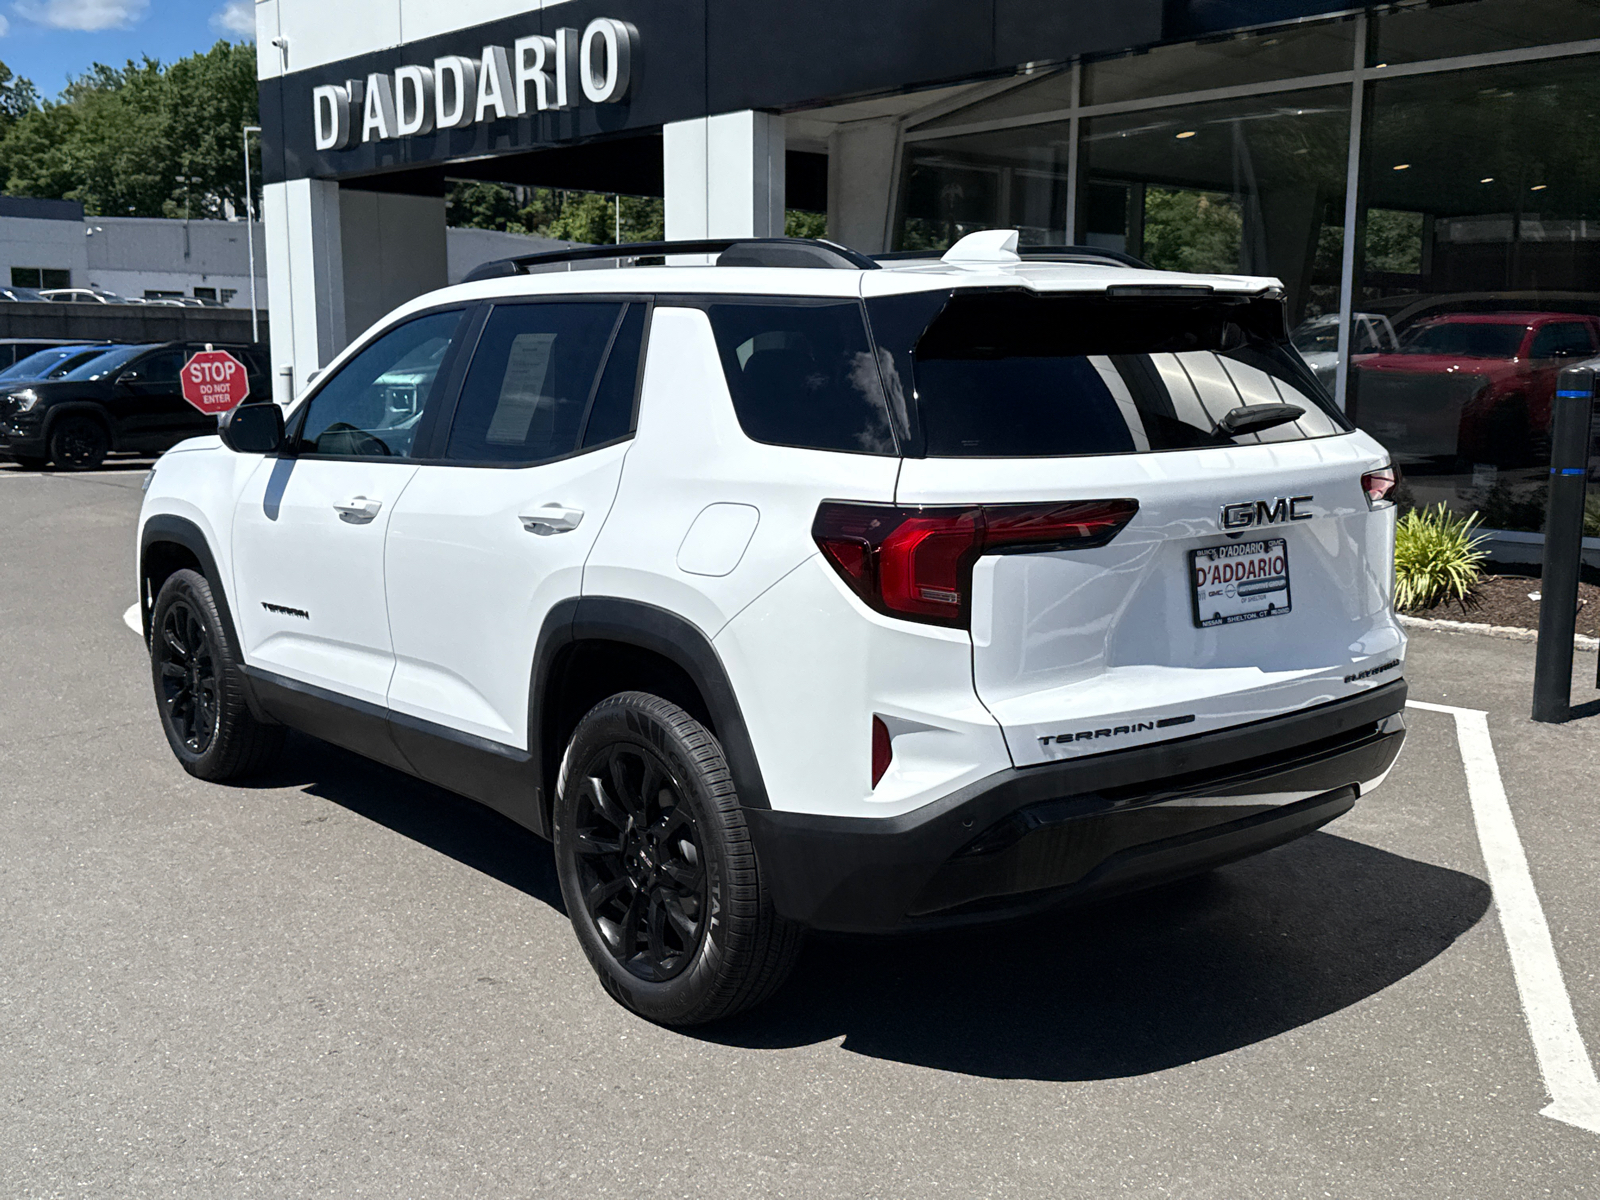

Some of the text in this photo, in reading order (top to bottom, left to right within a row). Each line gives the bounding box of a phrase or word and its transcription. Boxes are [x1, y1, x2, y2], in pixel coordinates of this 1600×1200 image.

[313, 17, 628, 150] D'ADDARIO
[189, 360, 236, 383] STOP
[200, 383, 231, 395] DO NOT
[203, 393, 231, 404] ENTER
[1219, 495, 1314, 531] GMC
[1219, 541, 1264, 558] D'ADDARIO
[1196, 555, 1285, 588] D'ADDARIO
[1202, 617, 1223, 627] NISSAN
[1259, 609, 1268, 617] CT
[1037, 721, 1154, 746] TERRAIN
